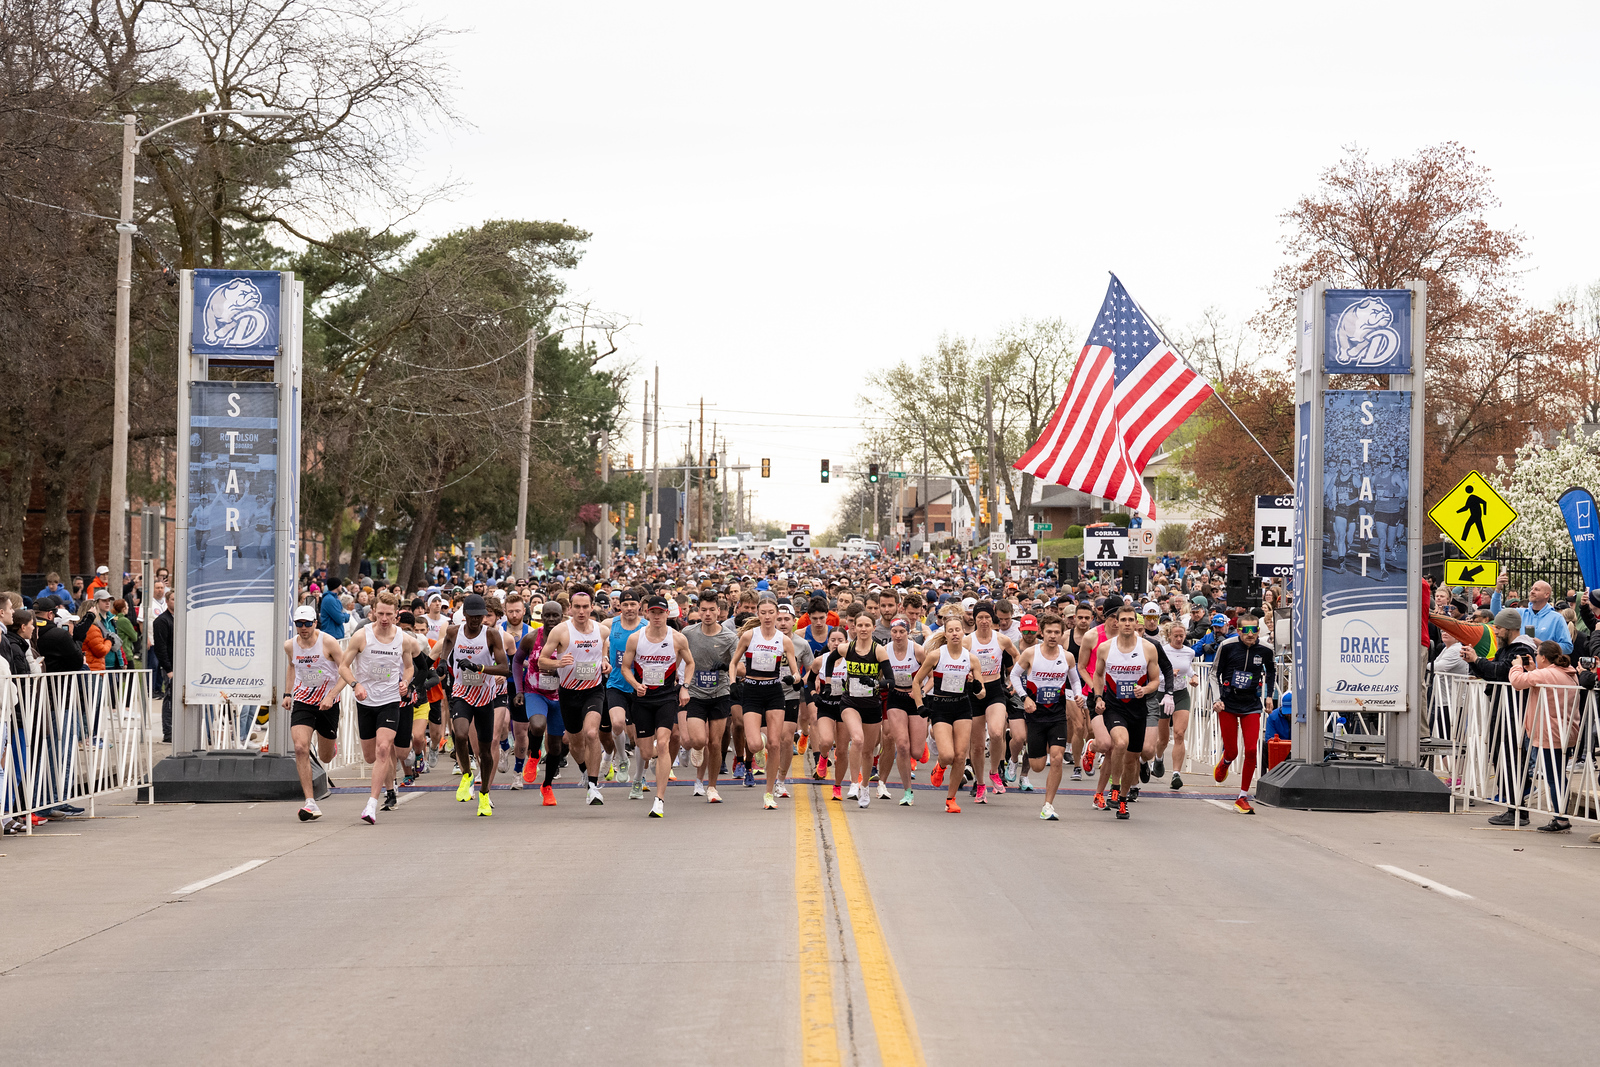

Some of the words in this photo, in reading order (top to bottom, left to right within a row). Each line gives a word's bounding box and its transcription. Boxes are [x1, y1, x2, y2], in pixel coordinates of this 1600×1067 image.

[792, 536, 804, 547] C
[1574, 534, 1595, 542] WATER
[1016, 546, 1031, 559] B
[1097, 539, 1118, 559] A
[205, 630, 255, 647] DRAKE
[1340, 637, 1389, 653] DRAKE
[205, 647, 227, 657] ROAD
[229, 647, 255, 657] RACES
[1340, 654, 1361, 663] ROAD
[1364, 654, 1389, 664] RACES
[576, 666, 595, 674] 2036
[200, 673, 235, 685] Drake
[236, 678, 264, 686] RELAYS
[1235, 675, 1249, 683] 237
[1335, 679, 1370, 692] Drake
[1371, 684, 1399, 692] RELAYS
